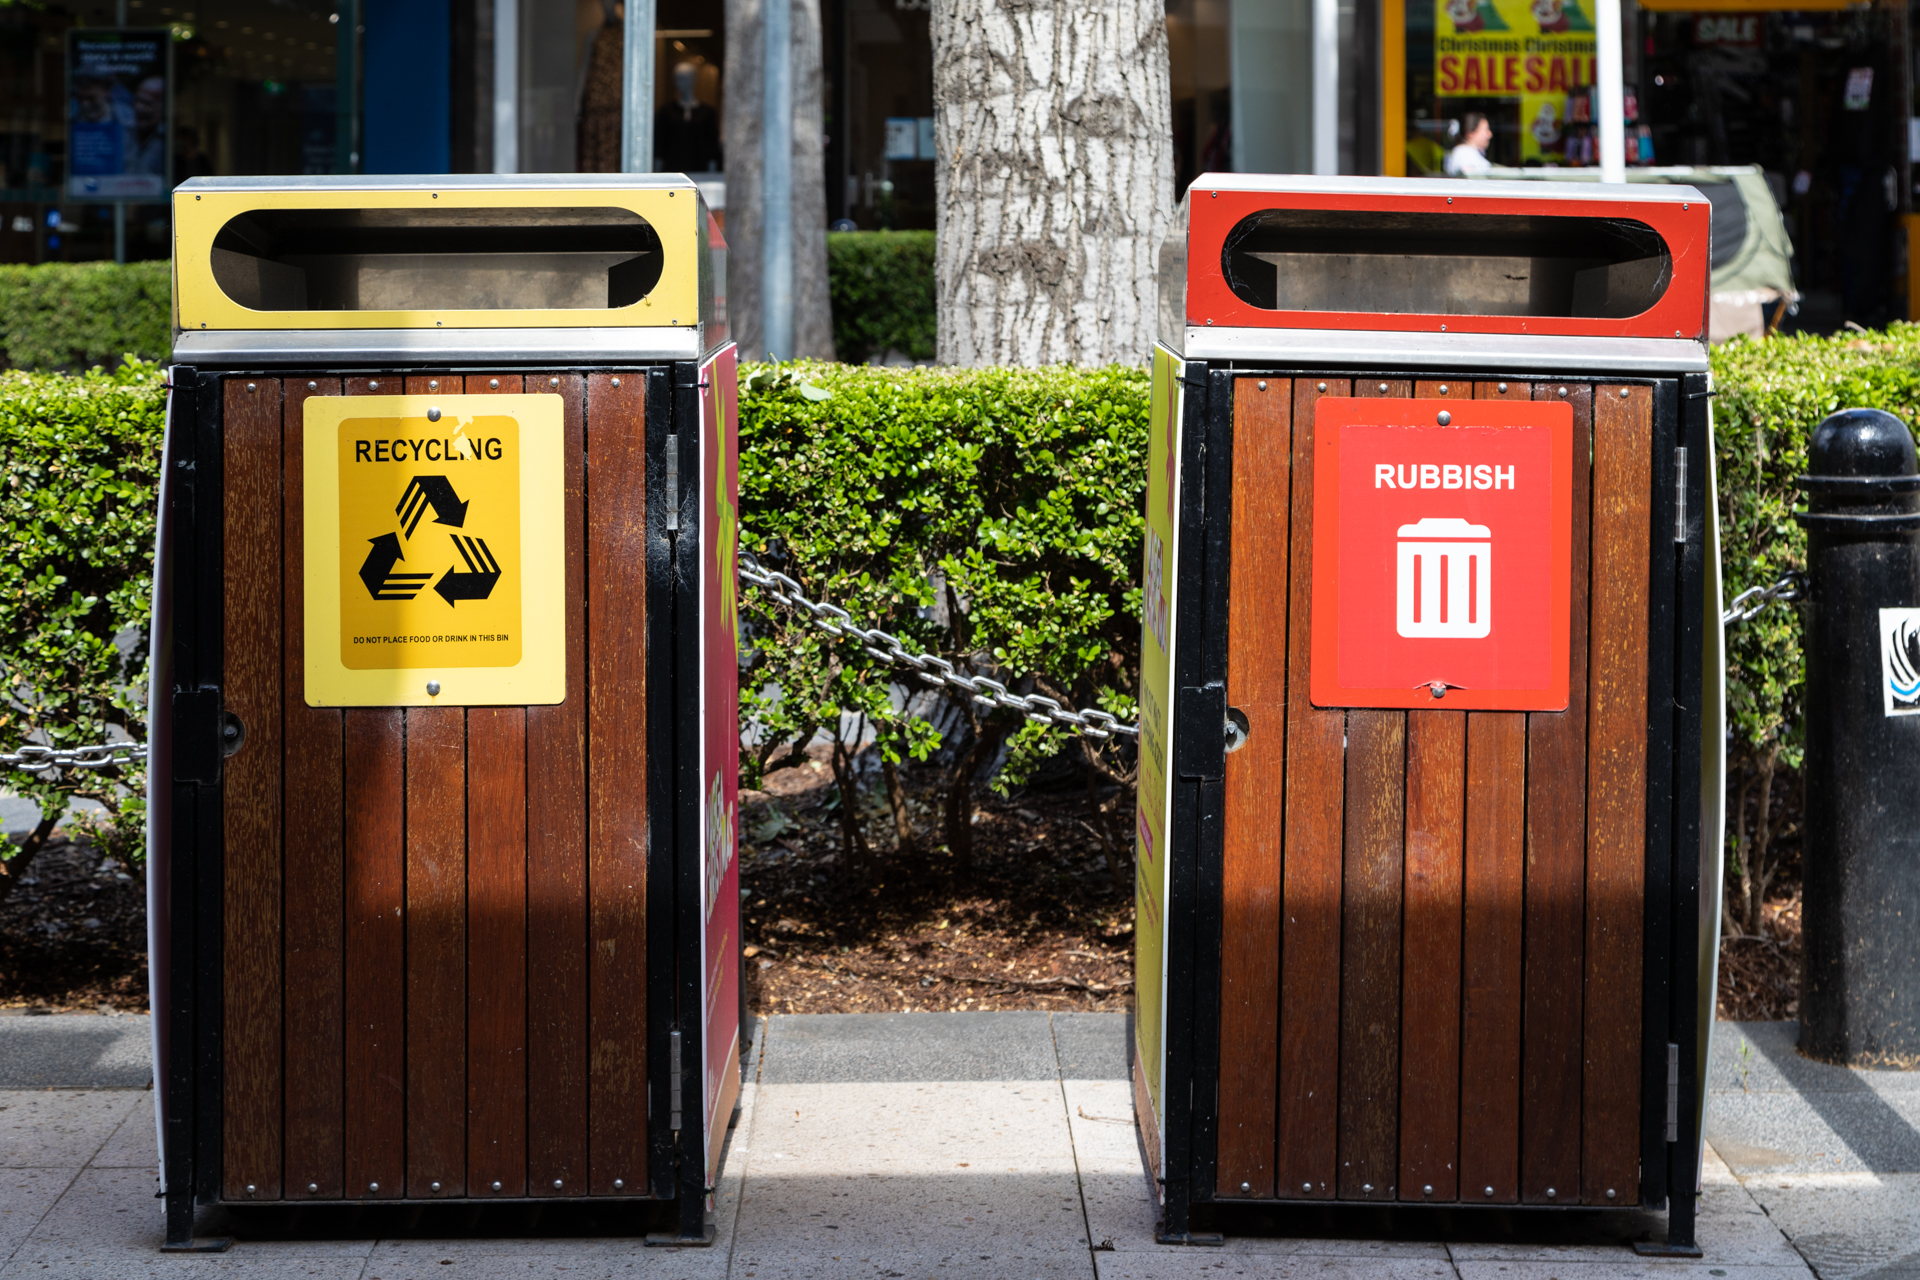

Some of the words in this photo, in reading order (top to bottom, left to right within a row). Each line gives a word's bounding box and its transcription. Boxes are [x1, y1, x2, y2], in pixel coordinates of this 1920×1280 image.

[1697, 16, 1759, 41] SALE
[1440, 36, 1520, 53] Christmas
[1524, 36, 1596, 53] Christma
[1440, 55, 1520, 92] SALE
[1375, 463, 1515, 490] RUBBISH
[353, 636, 365, 644] DO
[366, 636, 382, 644] NOT
[383, 635, 408, 644] PLACE
[409, 635, 431, 643] FOOD
[432, 635, 444, 643] OR
[445, 634, 468, 643] DRINK
[469, 634, 477, 642] IN
[478, 634, 496, 642] THIS
[496, 634, 509, 642] BIN
